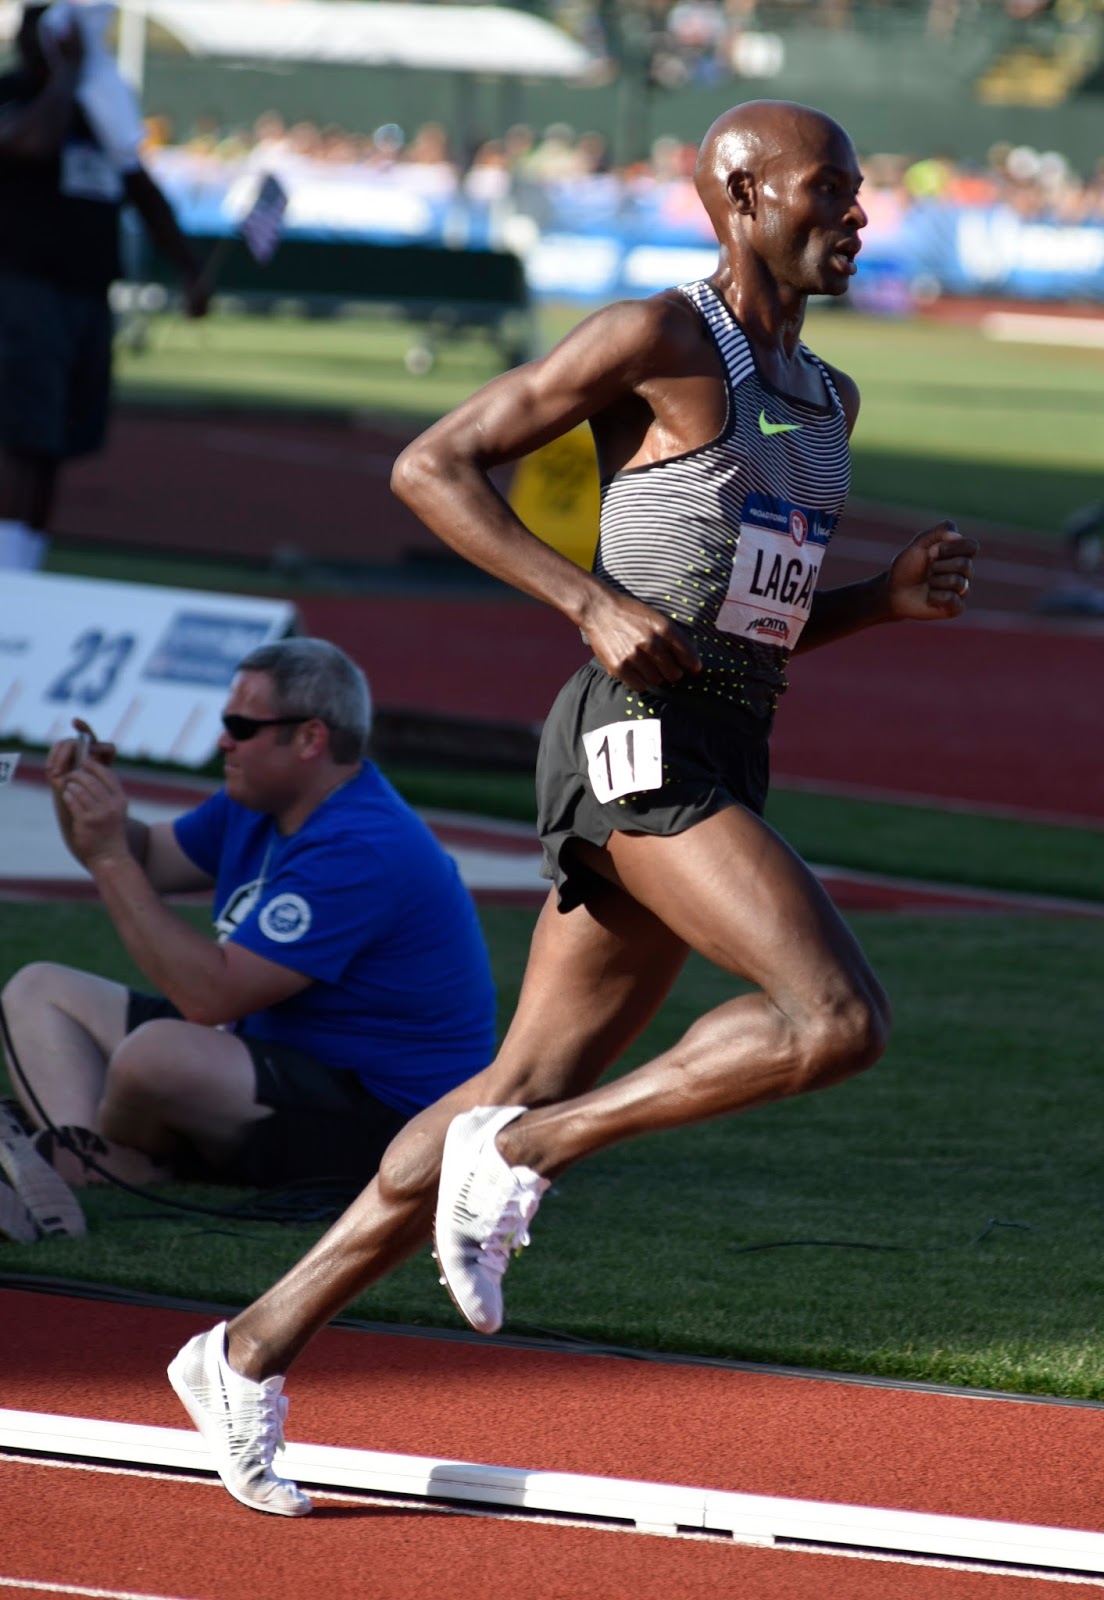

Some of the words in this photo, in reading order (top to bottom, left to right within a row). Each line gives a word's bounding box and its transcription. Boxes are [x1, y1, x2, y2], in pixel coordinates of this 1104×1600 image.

[750, 549, 817, 609] LAGA
[49, 629, 135, 705] 23
[596, 729, 635, 791] 11
